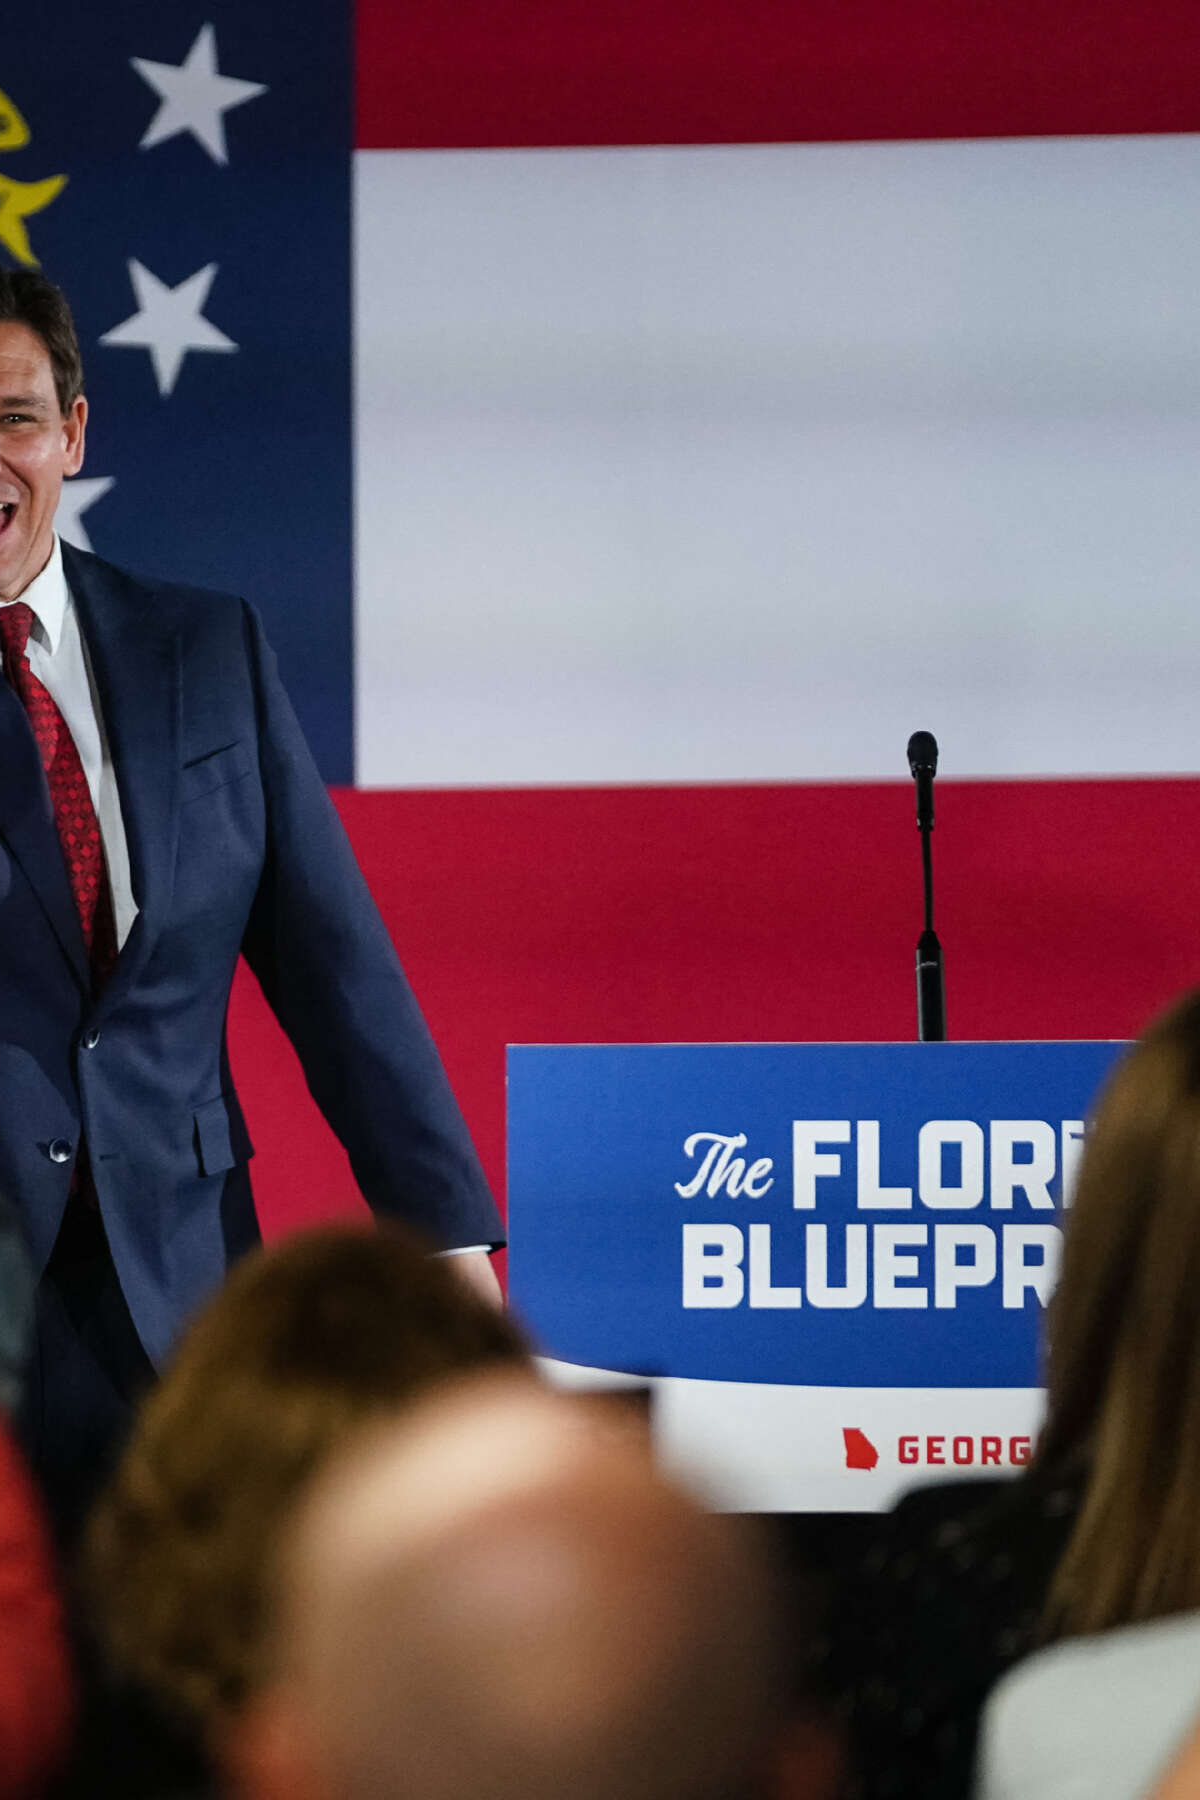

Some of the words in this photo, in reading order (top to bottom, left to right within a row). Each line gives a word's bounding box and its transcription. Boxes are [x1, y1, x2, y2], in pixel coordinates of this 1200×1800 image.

[674, 1132, 775, 1199] The
[681, 1224, 1065, 1309] BLUEPR
[897, 1435, 1033, 1466] GEORG
